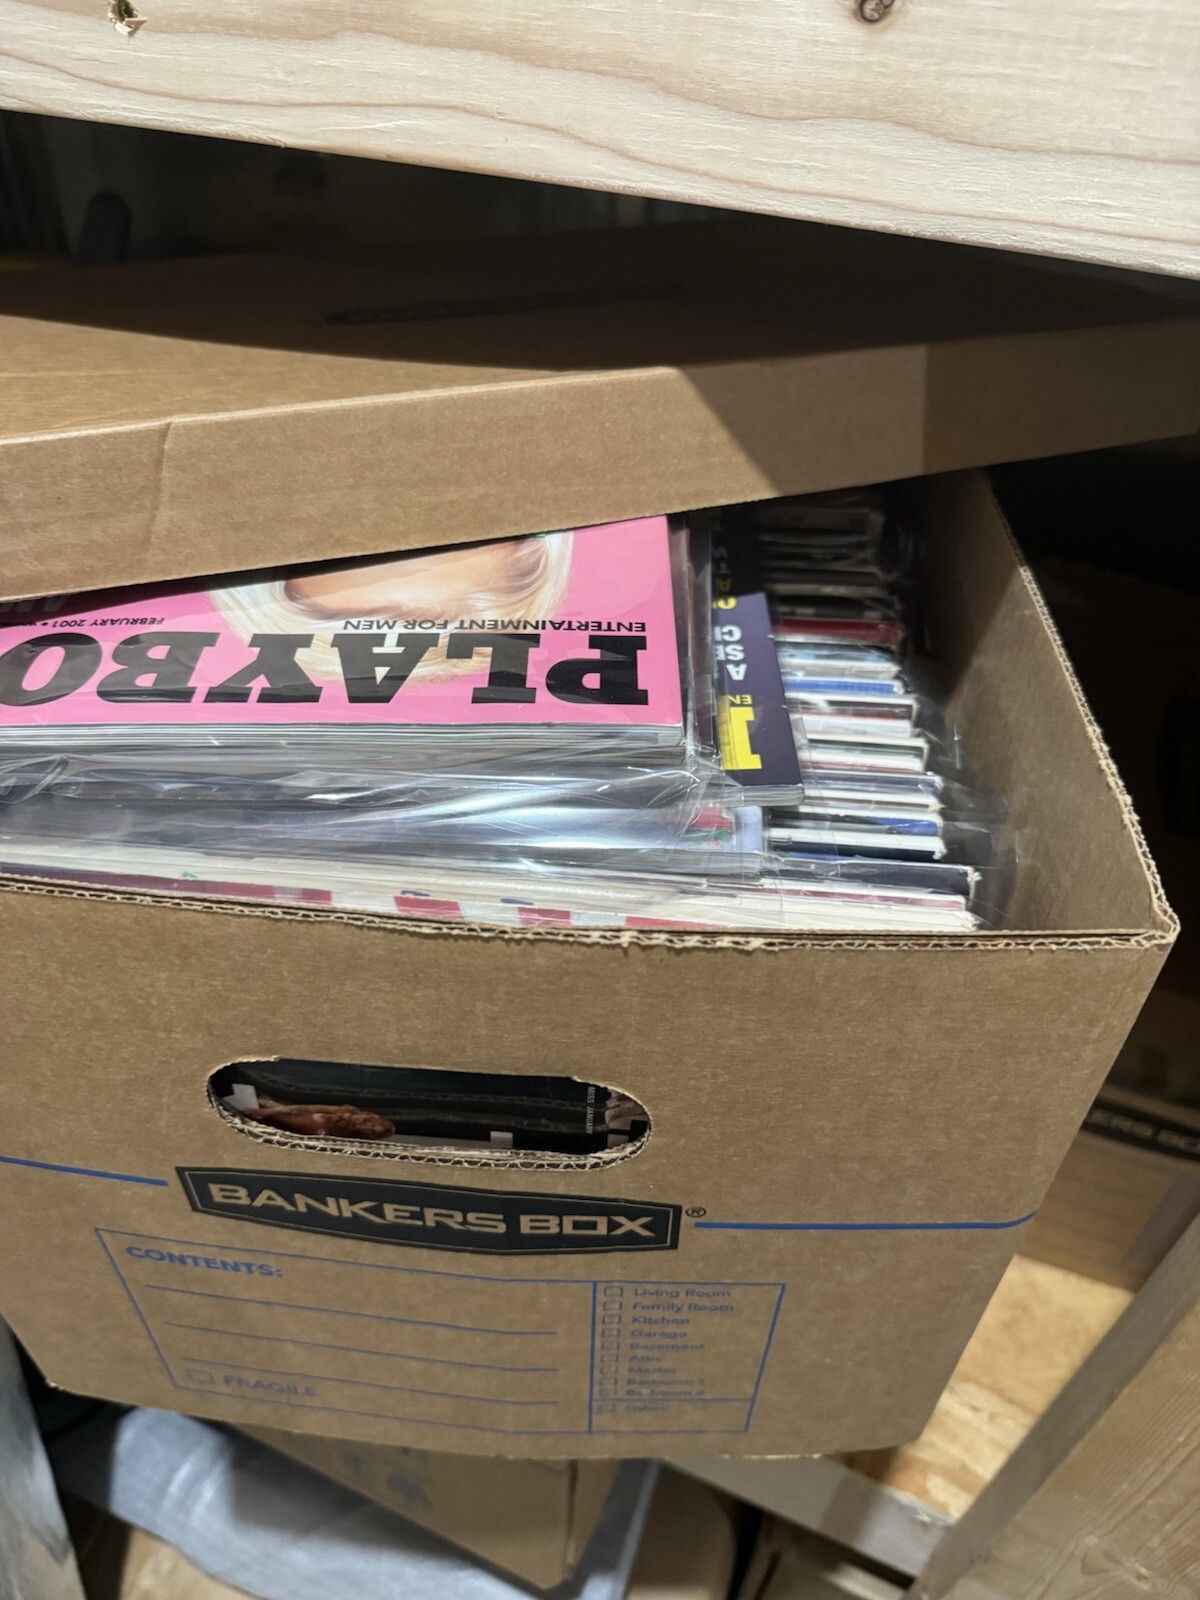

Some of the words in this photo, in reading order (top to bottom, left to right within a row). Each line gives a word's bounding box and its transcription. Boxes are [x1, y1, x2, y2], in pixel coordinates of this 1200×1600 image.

[52, 618, 88, 628] 2001
[88, 616, 166, 627] FEBRUARY
[343, 617, 398, 633] MEN
[403, 618, 449, 632] FOR
[455, 617, 647, 633] ENTERTAINMENT
[587, 1086, 596, 1103] MISS
[586, 1107, 594, 1134] JANUARY
[208, 1183, 507, 1234] BANKERS
[519, 1214, 656, 1237] BOX
[126, 1246, 283, 1277] CONTENTS:
[634, 1287, 680, 1298] Living
[685, 1288, 731, 1297] Room
[632, 1302, 684, 1312] Family
[688, 1303, 734, 1312] Room
[631, 1315, 690, 1325] Kitchen
[630, 1329, 688, 1339] Garage
[629, 1342, 704, 1350] Basement
[223, 1375, 317, 1397] FRAGILE
